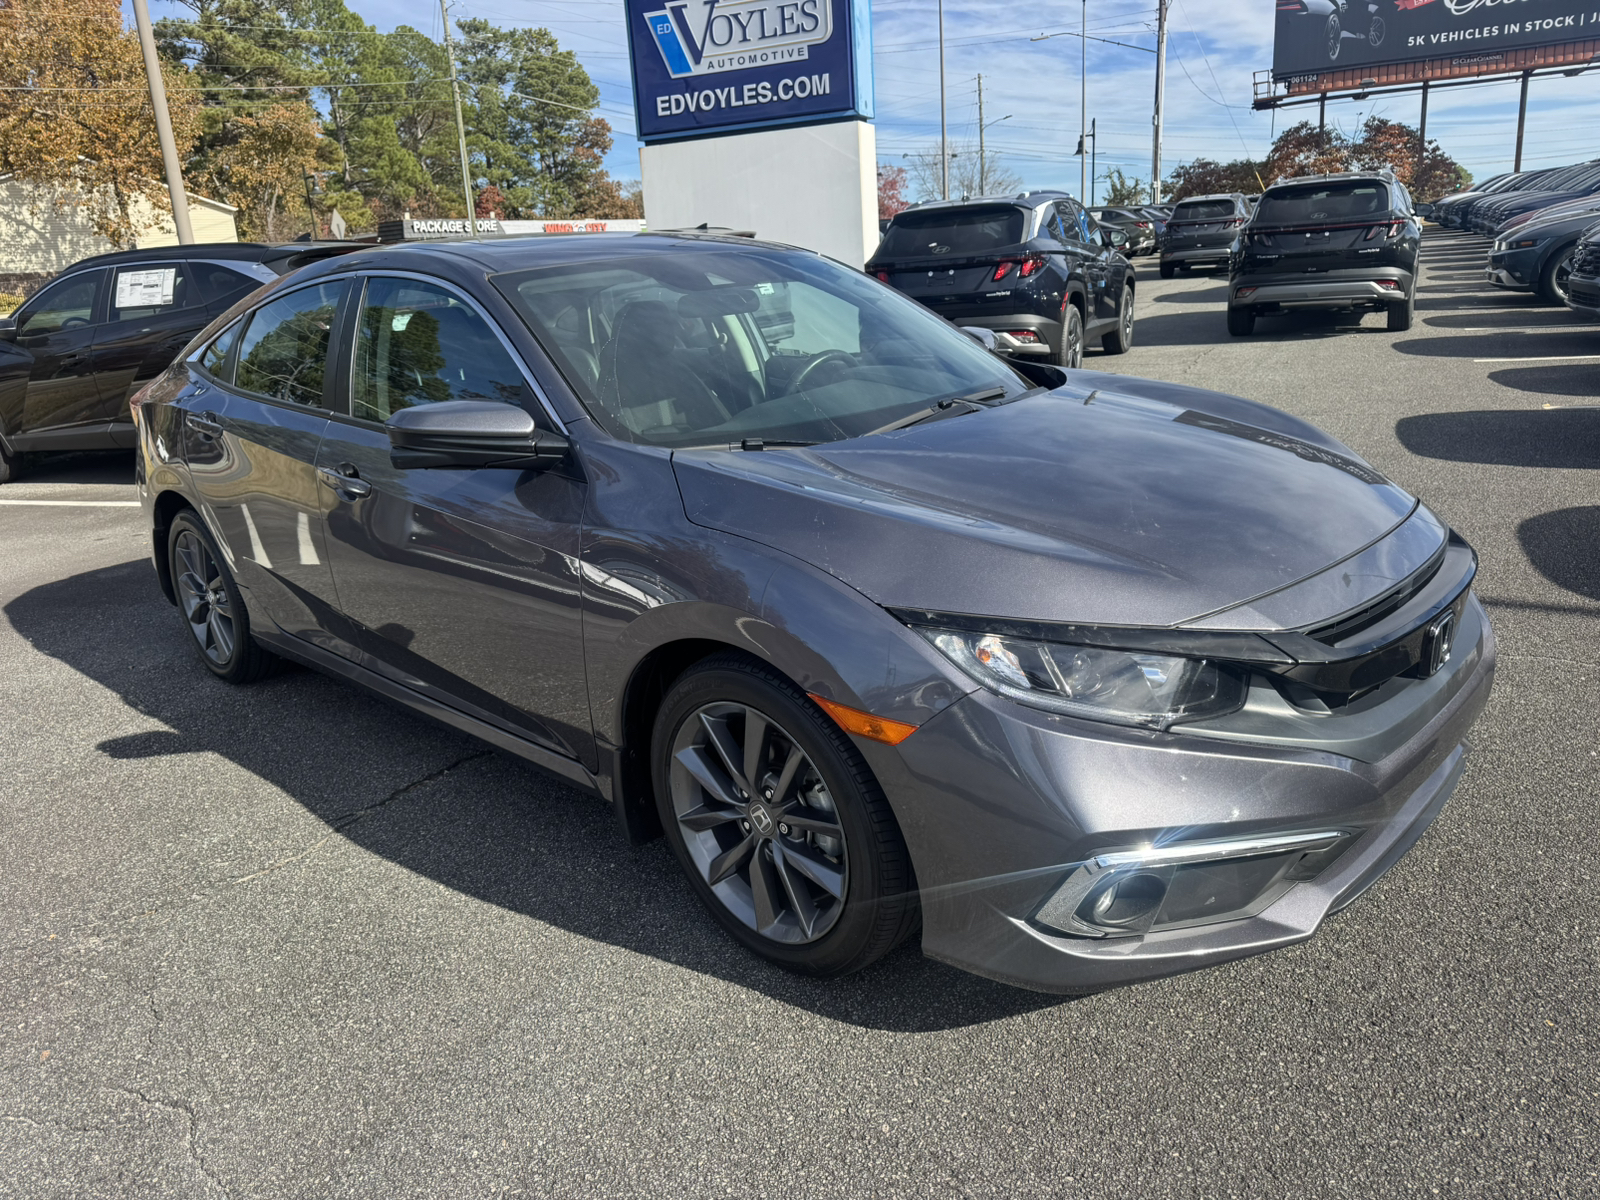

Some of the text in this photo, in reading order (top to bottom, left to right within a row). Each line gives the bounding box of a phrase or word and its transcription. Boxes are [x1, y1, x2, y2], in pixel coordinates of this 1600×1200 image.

[656, 22, 672, 35] ED
[669, 0, 820, 64] VOYLES
[1407, 35, 1426, 47] 5K
[1430, 25, 1499, 44] VEHICLES
[1504, 22, 1520, 35] IN
[1524, 14, 1575, 32] STOCK
[707, 46, 805, 70] AUTOMOTIVE
[1290, 74, 1318, 84] 061124
[656, 73, 831, 117] EDVOYLES.COM
[413, 220, 498, 233] PACKAGE SORE
[585, 223, 608, 233] CITY
